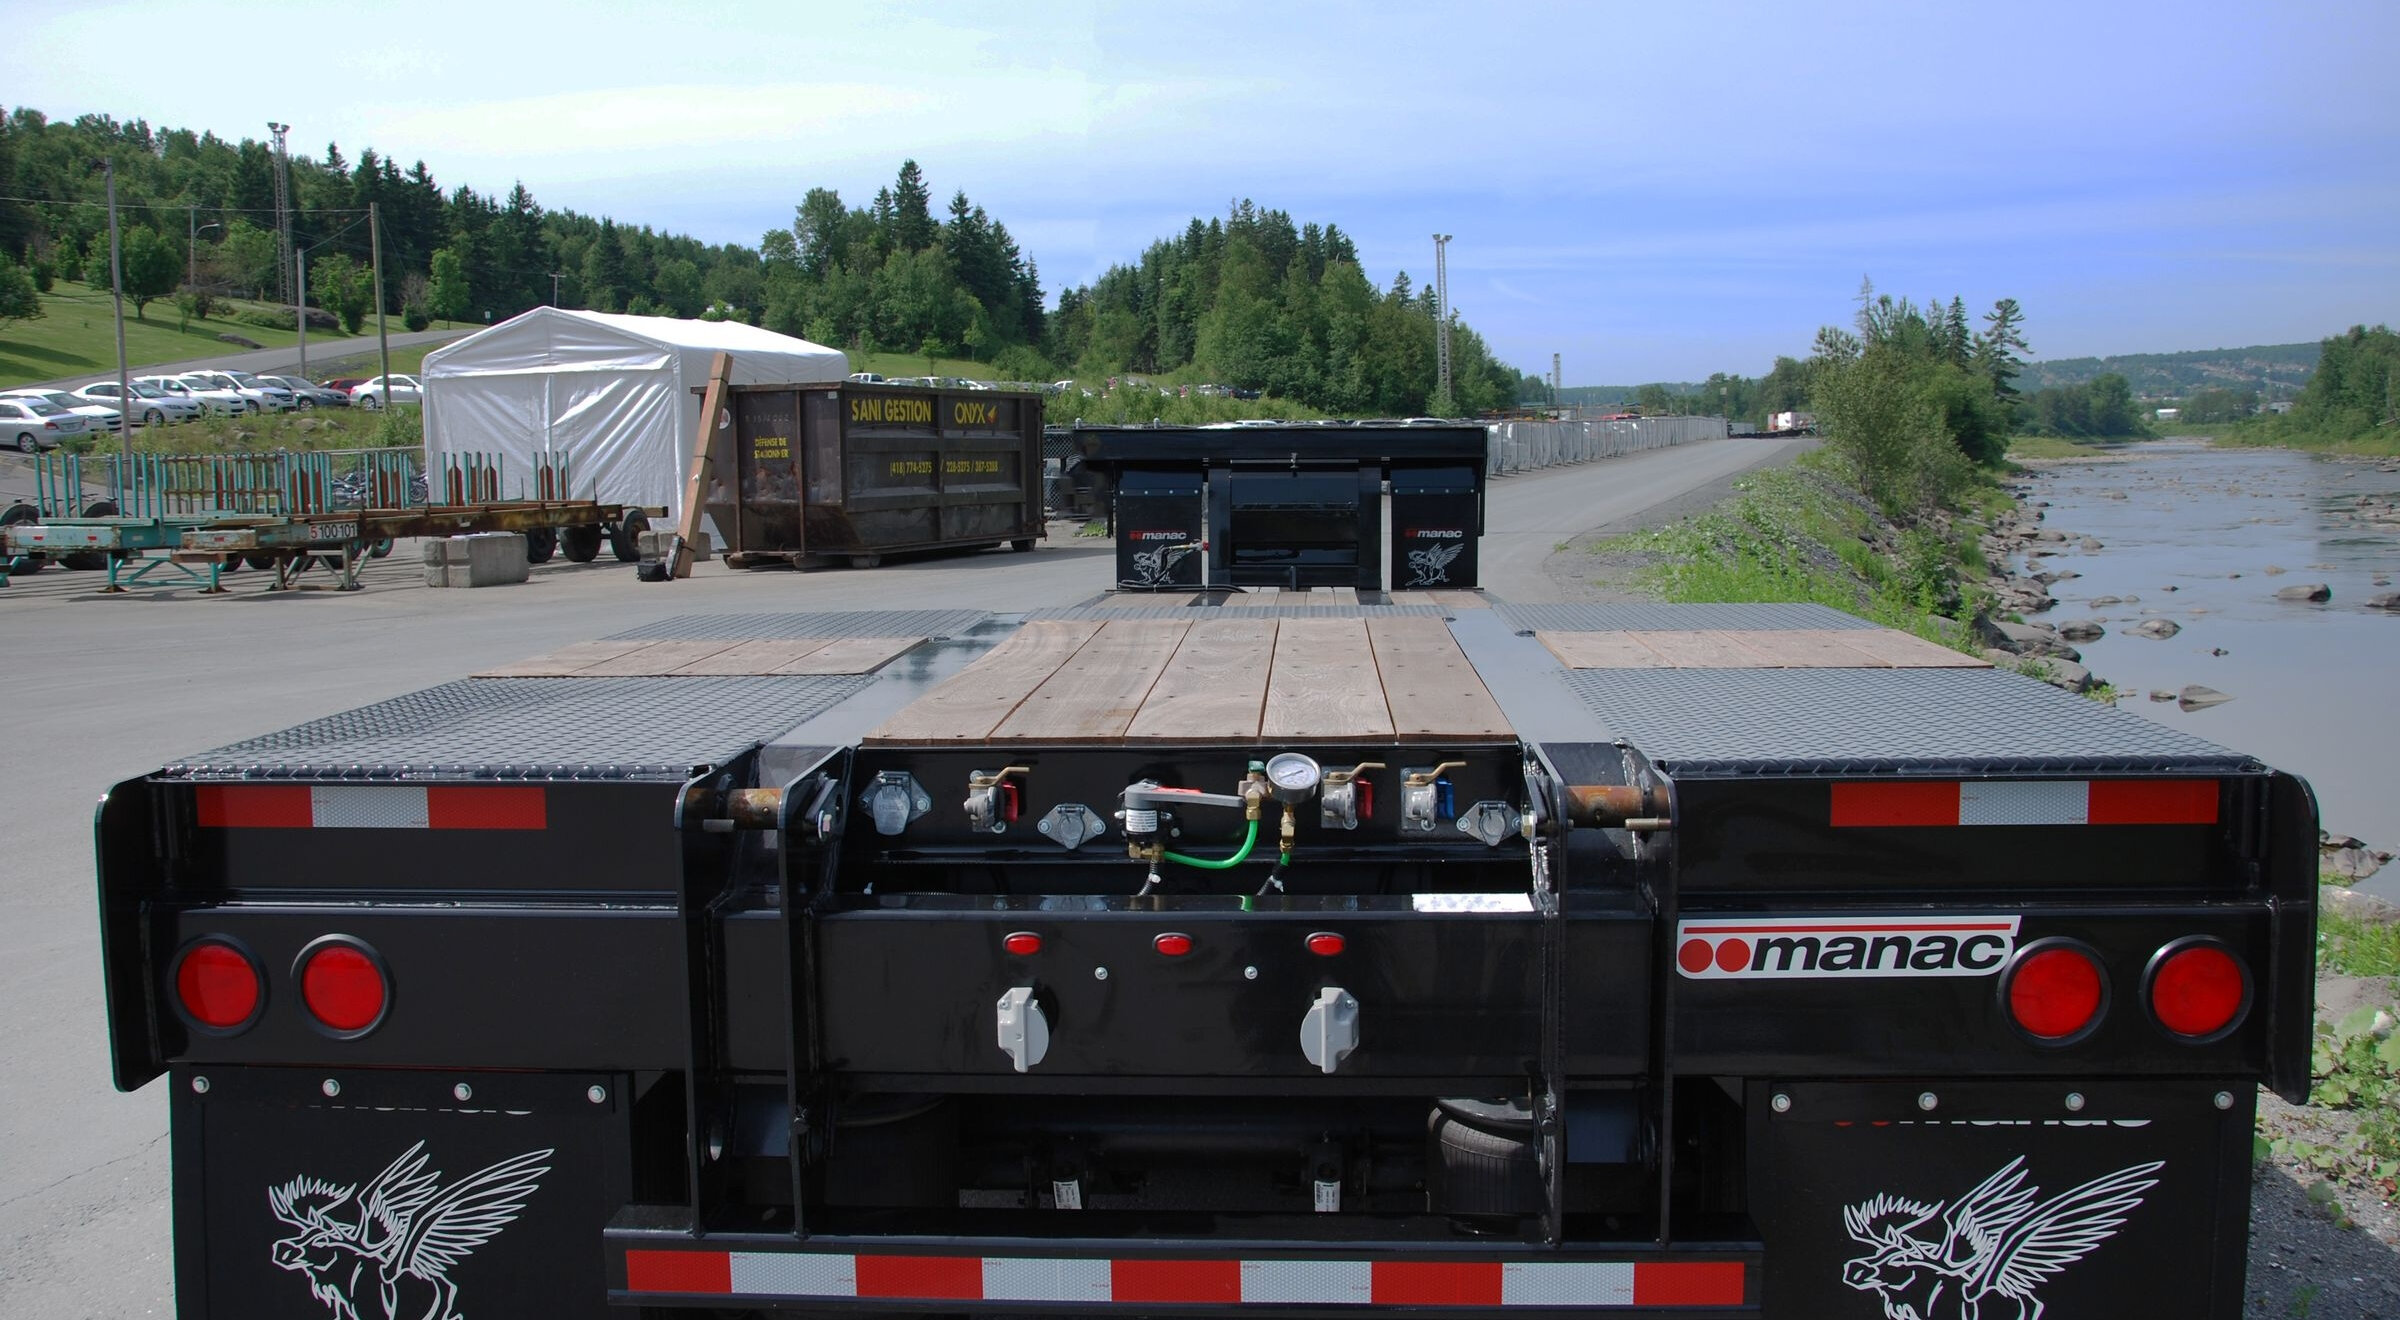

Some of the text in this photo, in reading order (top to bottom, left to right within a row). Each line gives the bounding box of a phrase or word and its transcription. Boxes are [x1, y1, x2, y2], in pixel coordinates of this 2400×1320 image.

[852, 399, 986, 424] SANI GESTION ONYX
[1142, 532, 1187, 540] manac
[1417, 530, 1463, 538] manac
[1750, 934, 2006, 971] manac
